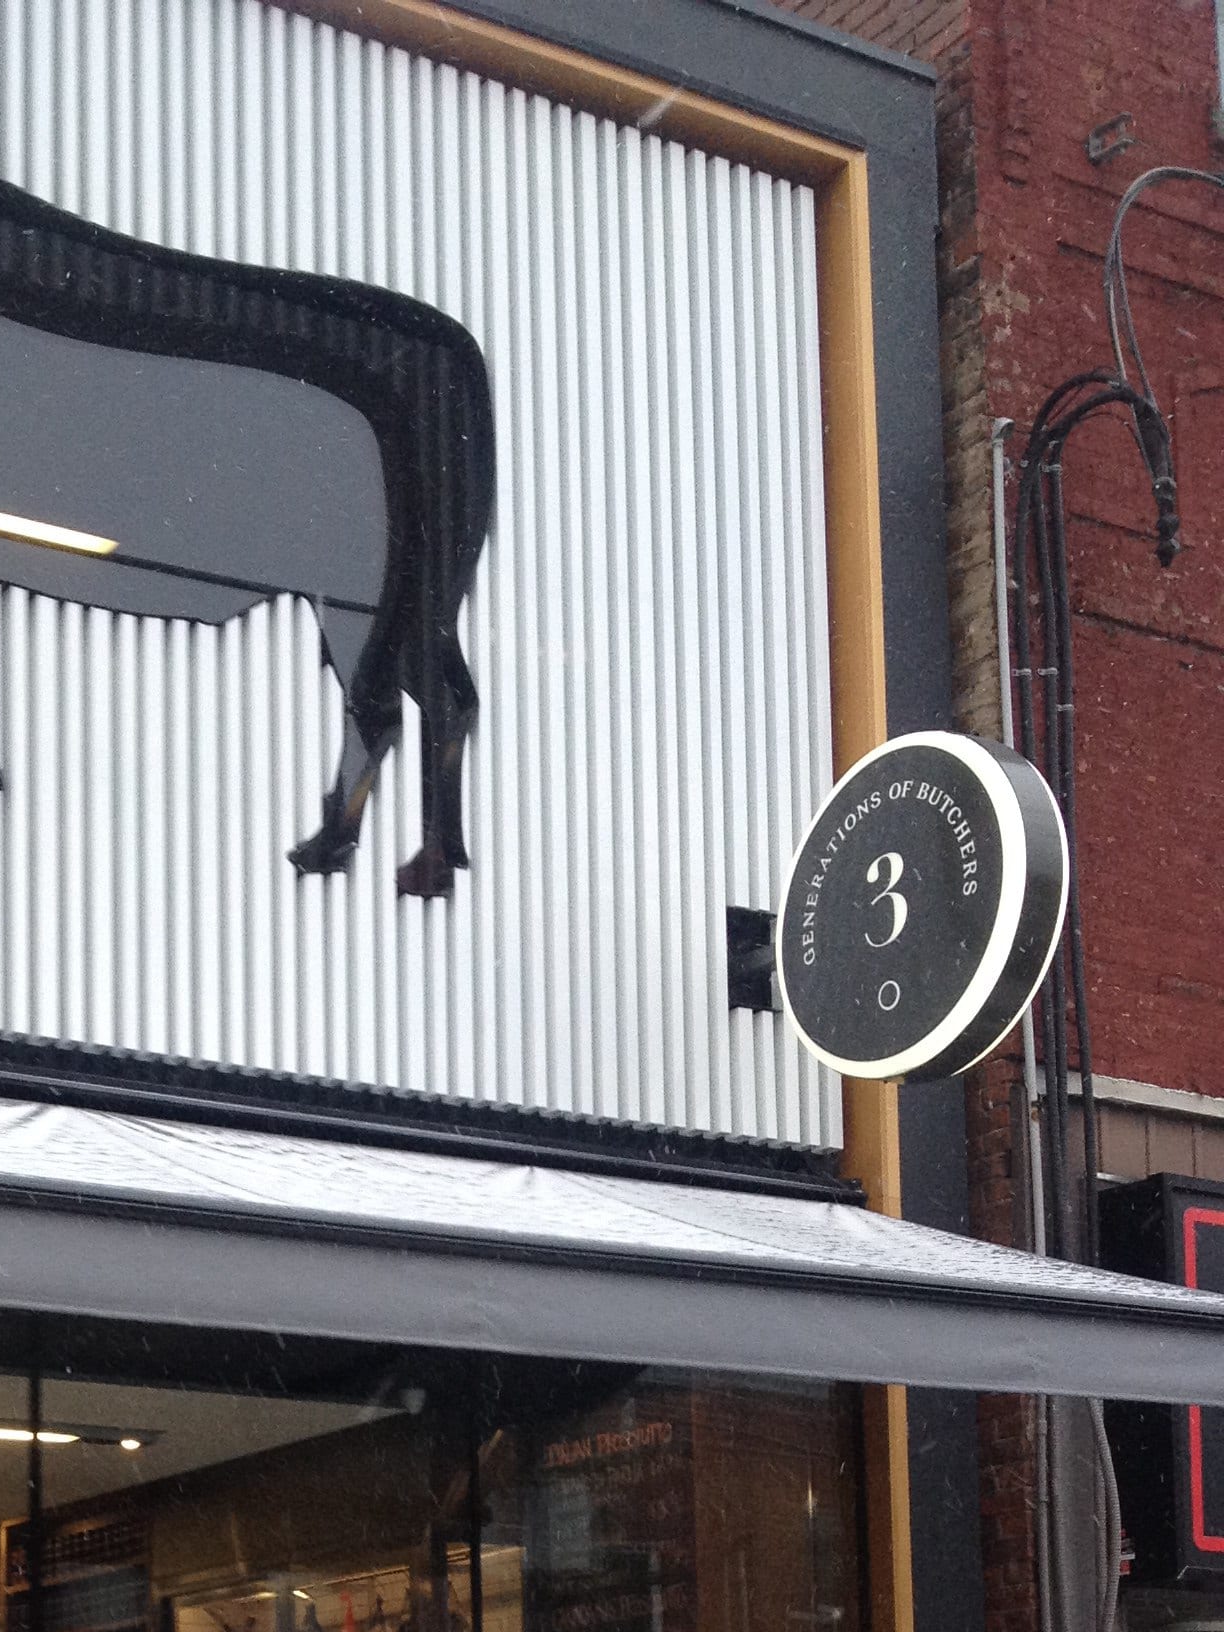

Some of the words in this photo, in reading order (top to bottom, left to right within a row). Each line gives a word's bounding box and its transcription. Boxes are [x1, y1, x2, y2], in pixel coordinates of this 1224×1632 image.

[802, 791, 882, 966] GENERATIONS
[888, 780, 914, 801] OF
[916, 782, 978, 896] BUTCHERS
[864, 852, 908, 948] 3
